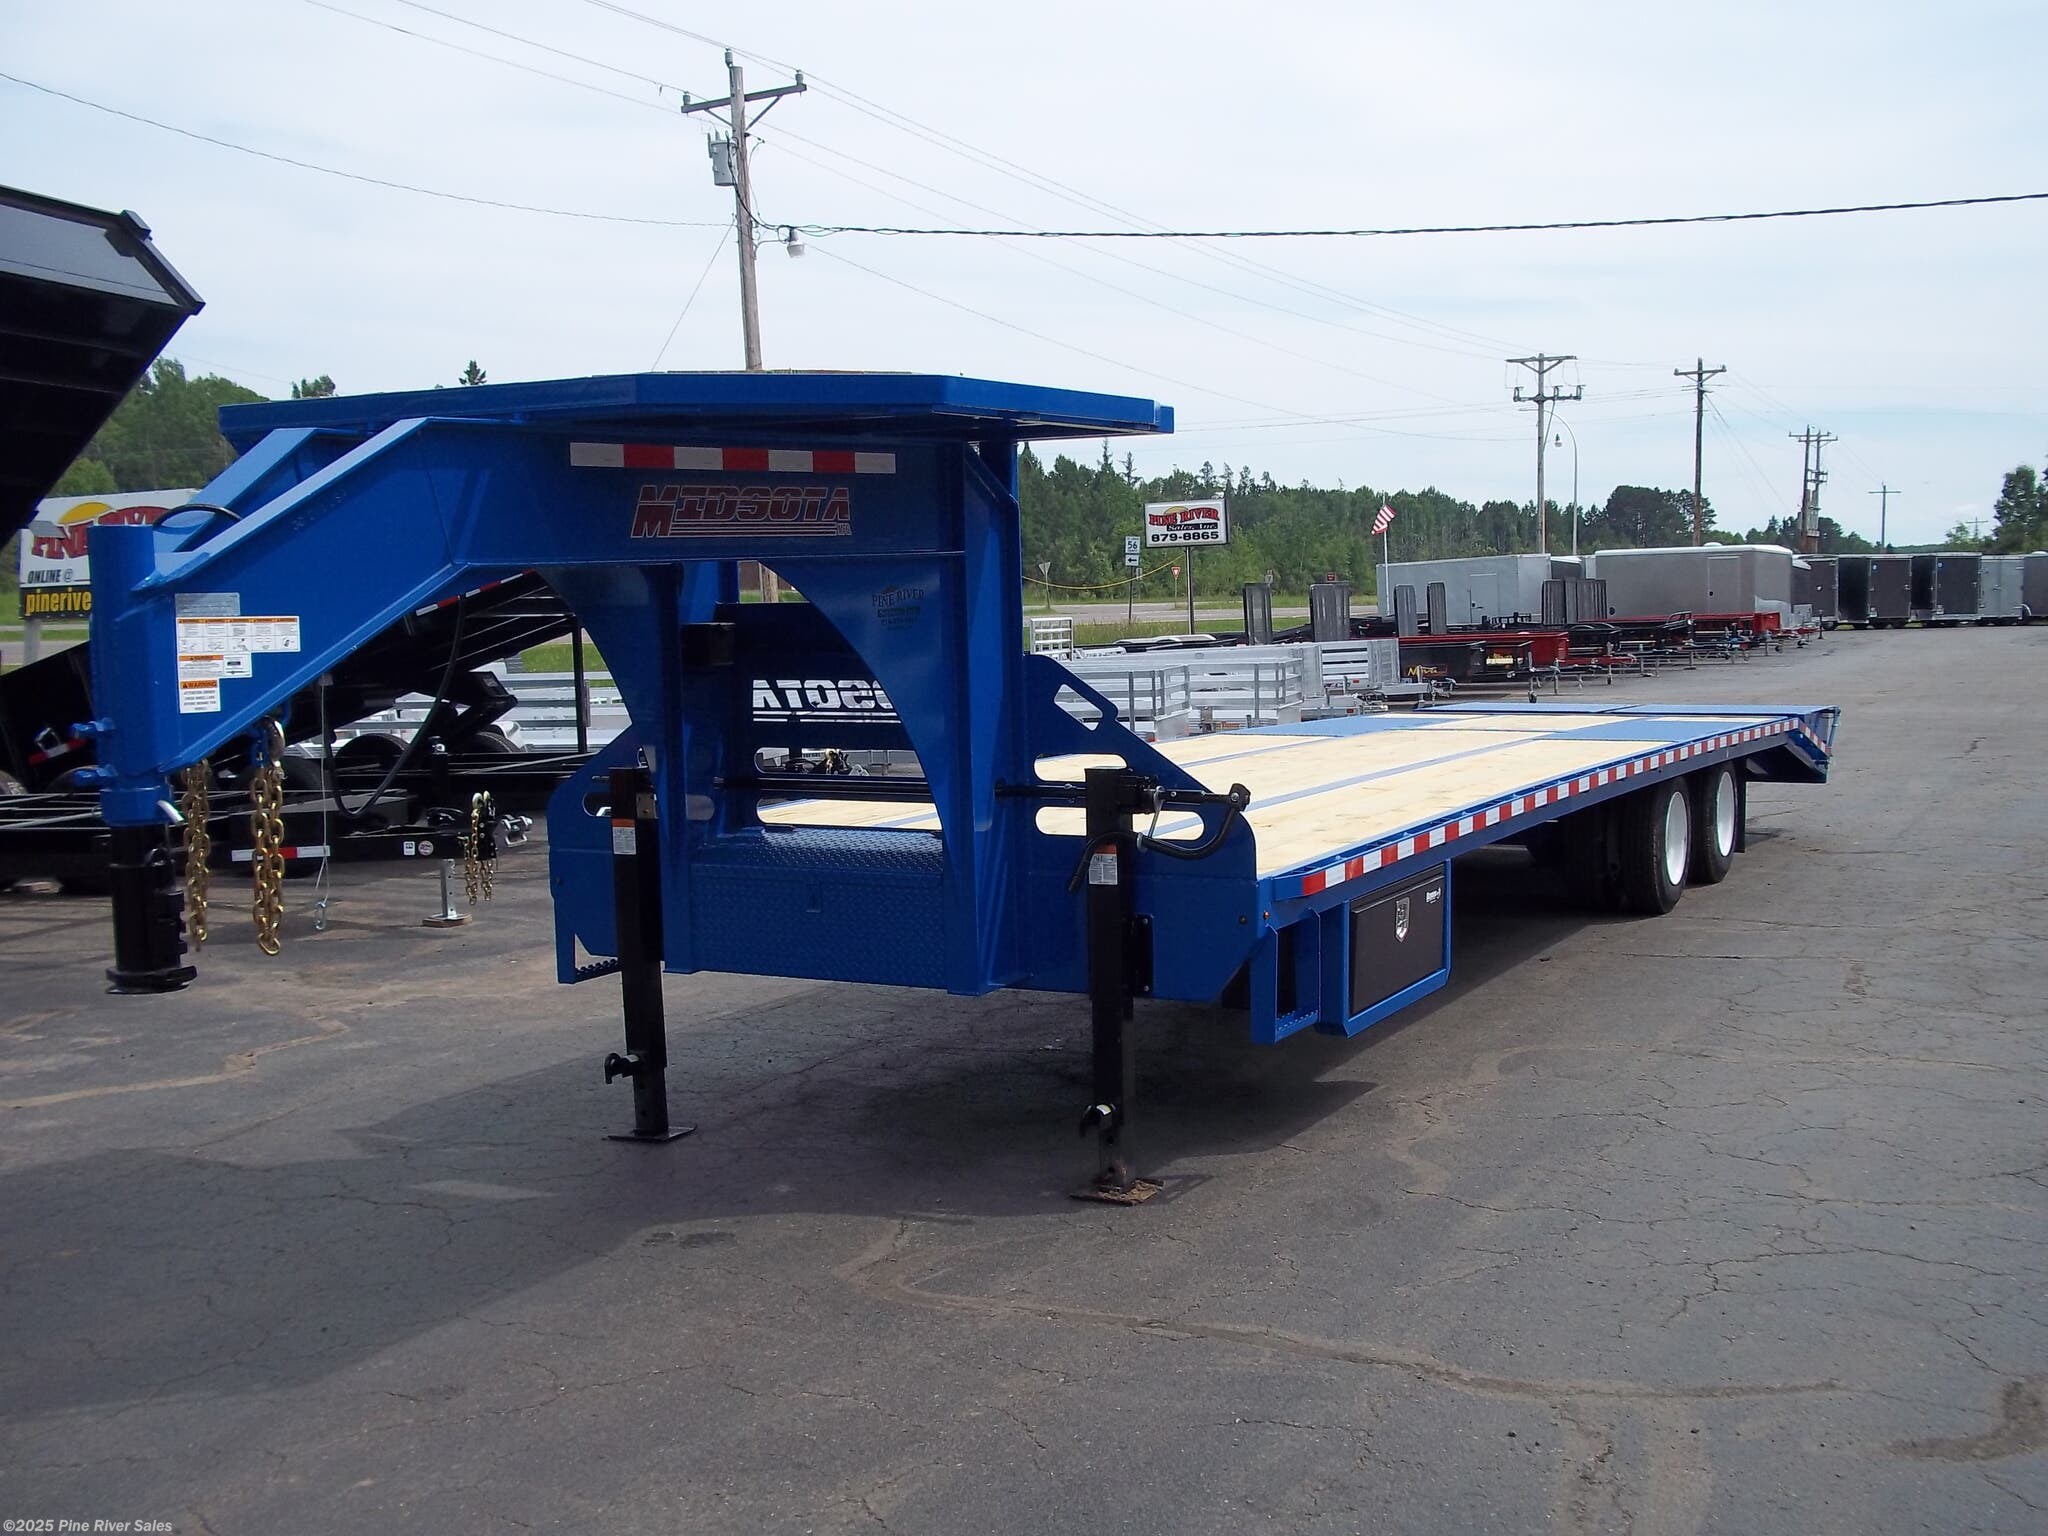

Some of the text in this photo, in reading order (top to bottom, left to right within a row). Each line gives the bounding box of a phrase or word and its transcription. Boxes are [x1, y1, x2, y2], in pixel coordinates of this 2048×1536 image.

[631, 485, 850, 537] MIDSOTA
[1149, 507, 1220, 526] PINE RIVER
[1151, 531, 1219, 542] 879-8865
[1127, 541, 1138, 549] 56
[28, 569, 61, 584] ONLINE
